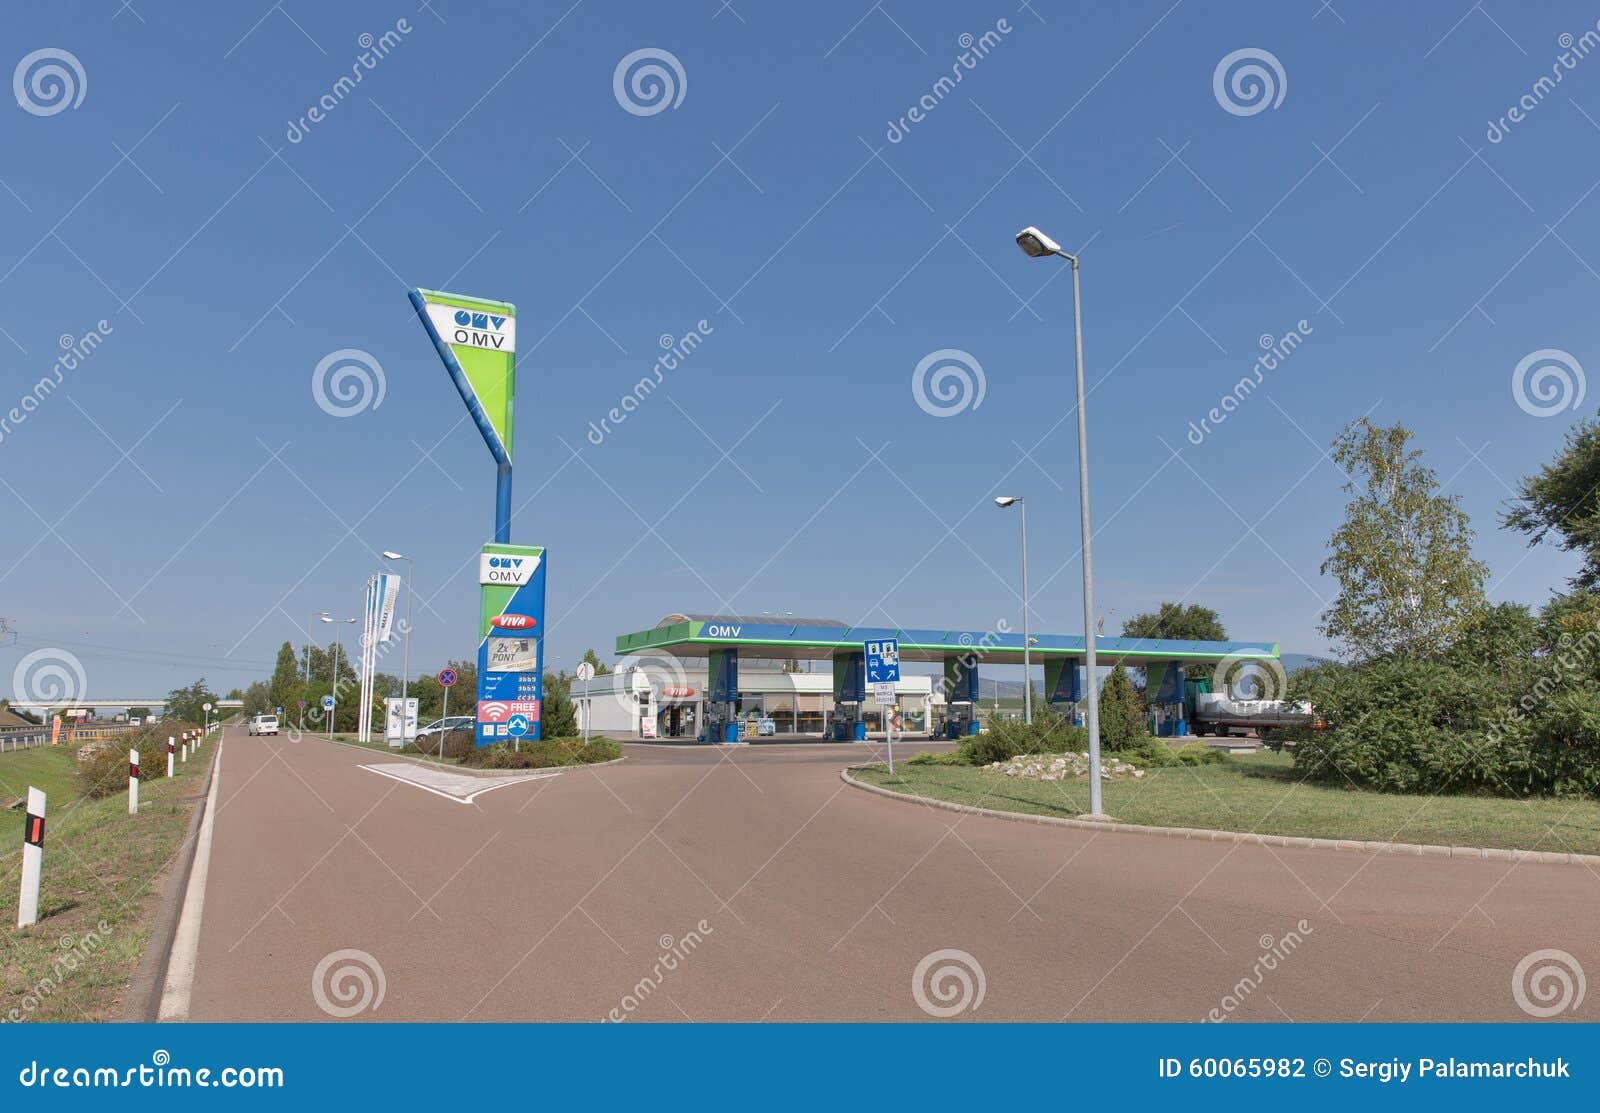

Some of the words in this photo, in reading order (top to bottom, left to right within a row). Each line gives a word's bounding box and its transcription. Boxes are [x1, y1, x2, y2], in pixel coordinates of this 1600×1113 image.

[454, 330, 505, 348] OMV
[489, 571, 522, 581] OMV
[500, 616, 526, 626] VIVA
[708, 625, 741, 637] OMV
[491, 653, 516, 662] PONT
[510, 702, 535, 711] FREE
